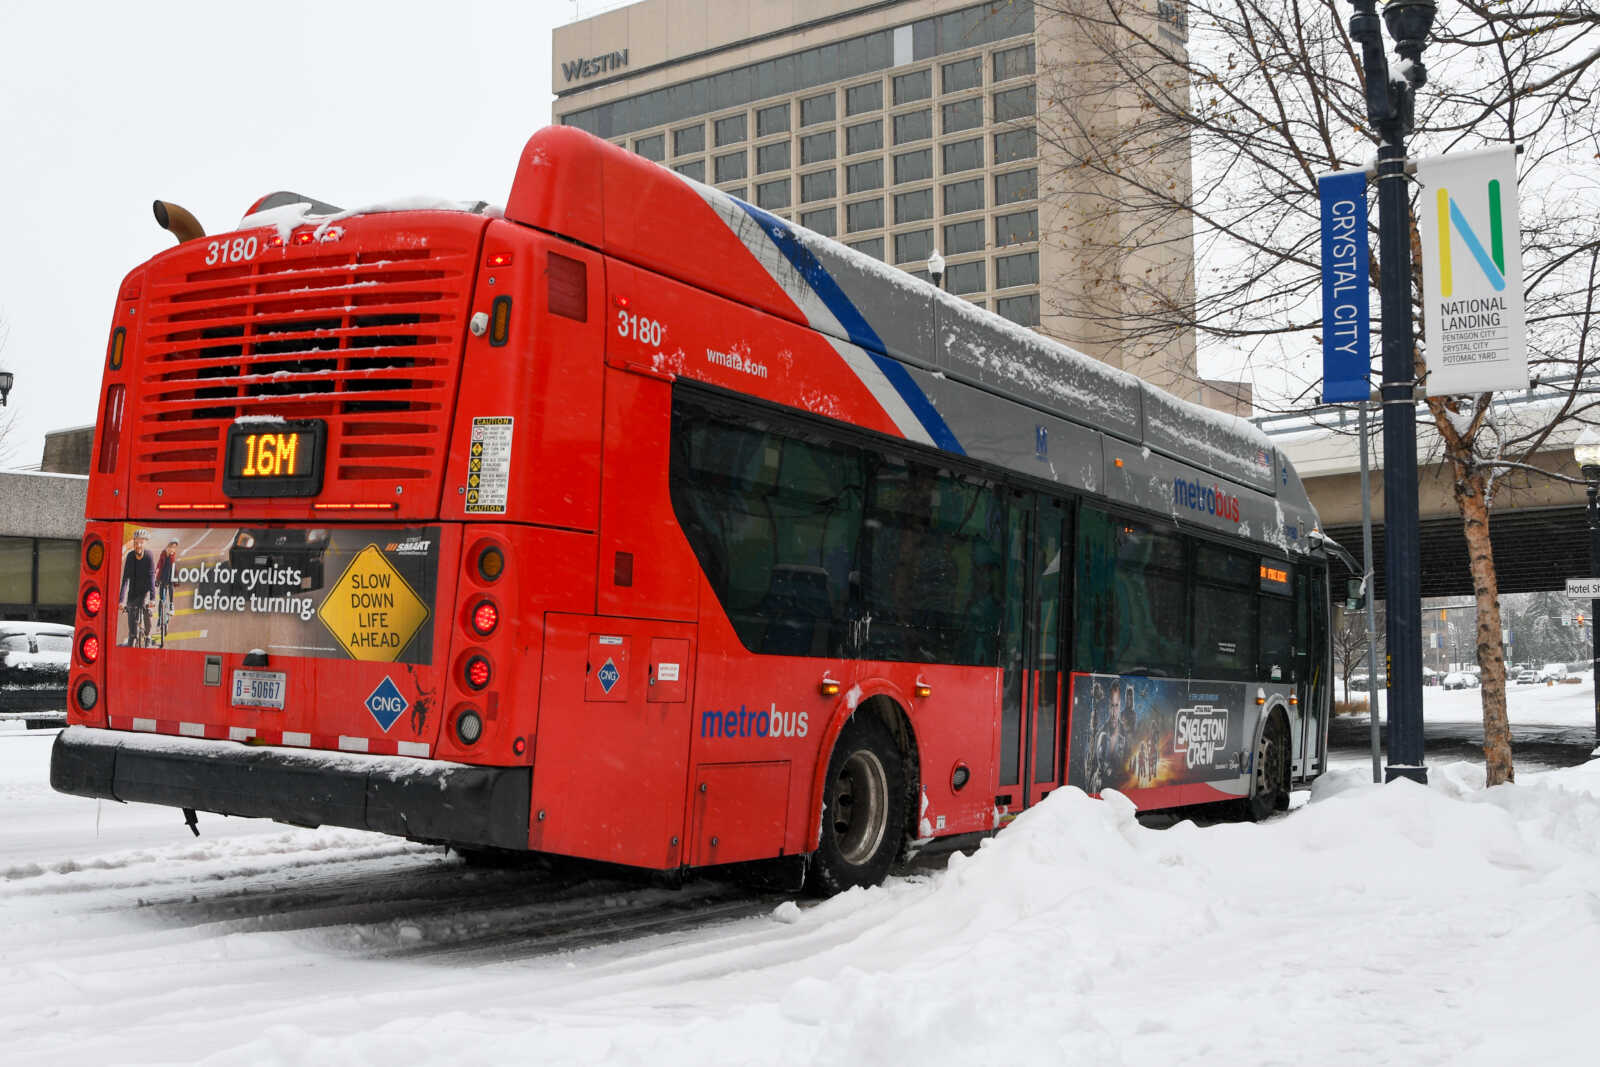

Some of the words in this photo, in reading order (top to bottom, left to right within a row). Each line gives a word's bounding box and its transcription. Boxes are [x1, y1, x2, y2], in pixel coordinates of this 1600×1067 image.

[561, 47, 629, 82] WESTIN
[205, 236, 258, 266] 3180
[1332, 200, 1357, 299] CRYSTAL
[1441, 297, 1507, 315] NATIONAL
[617, 310, 662, 347] 3180
[1334, 304, 1358, 355] CITY
[1441, 312, 1500, 330] LANDING
[1443, 332, 1479, 341] PENTAGON
[1480, 330, 1496, 338] CITY
[1443, 343, 1471, 352] CRYSTAL
[1472, 342, 1489, 350] CITY
[706, 347, 768, 379] wmata.com
[1443, 354, 1476, 363] POTOMAC
[1479, 352, 1496, 360] YARD
[476, 417, 509, 425] CAUTION
[242, 433, 297, 476] 16M
[468, 504, 502, 512] CAUTION
[1174, 476, 1240, 523] metrobus
[170, 562, 208, 584] Look
[214, 561, 237, 584] for
[241, 563, 302, 590] cyclists
[351, 573, 391, 589] SLOW
[1568, 584, 1590, 594] Hotel
[193, 588, 246, 611] before
[250, 591, 316, 621] turning.
[351, 593, 394, 609] DOWN
[358, 612, 389, 628] LIFE
[350, 632, 400, 648] AHEAD
[600, 670, 617, 681] CNG
[371, 695, 401, 712] CNG
[700, 702, 809, 738] metrobus
[1178, 715, 1226, 744] SKELETON
[1186, 741, 1215, 769] CREW
